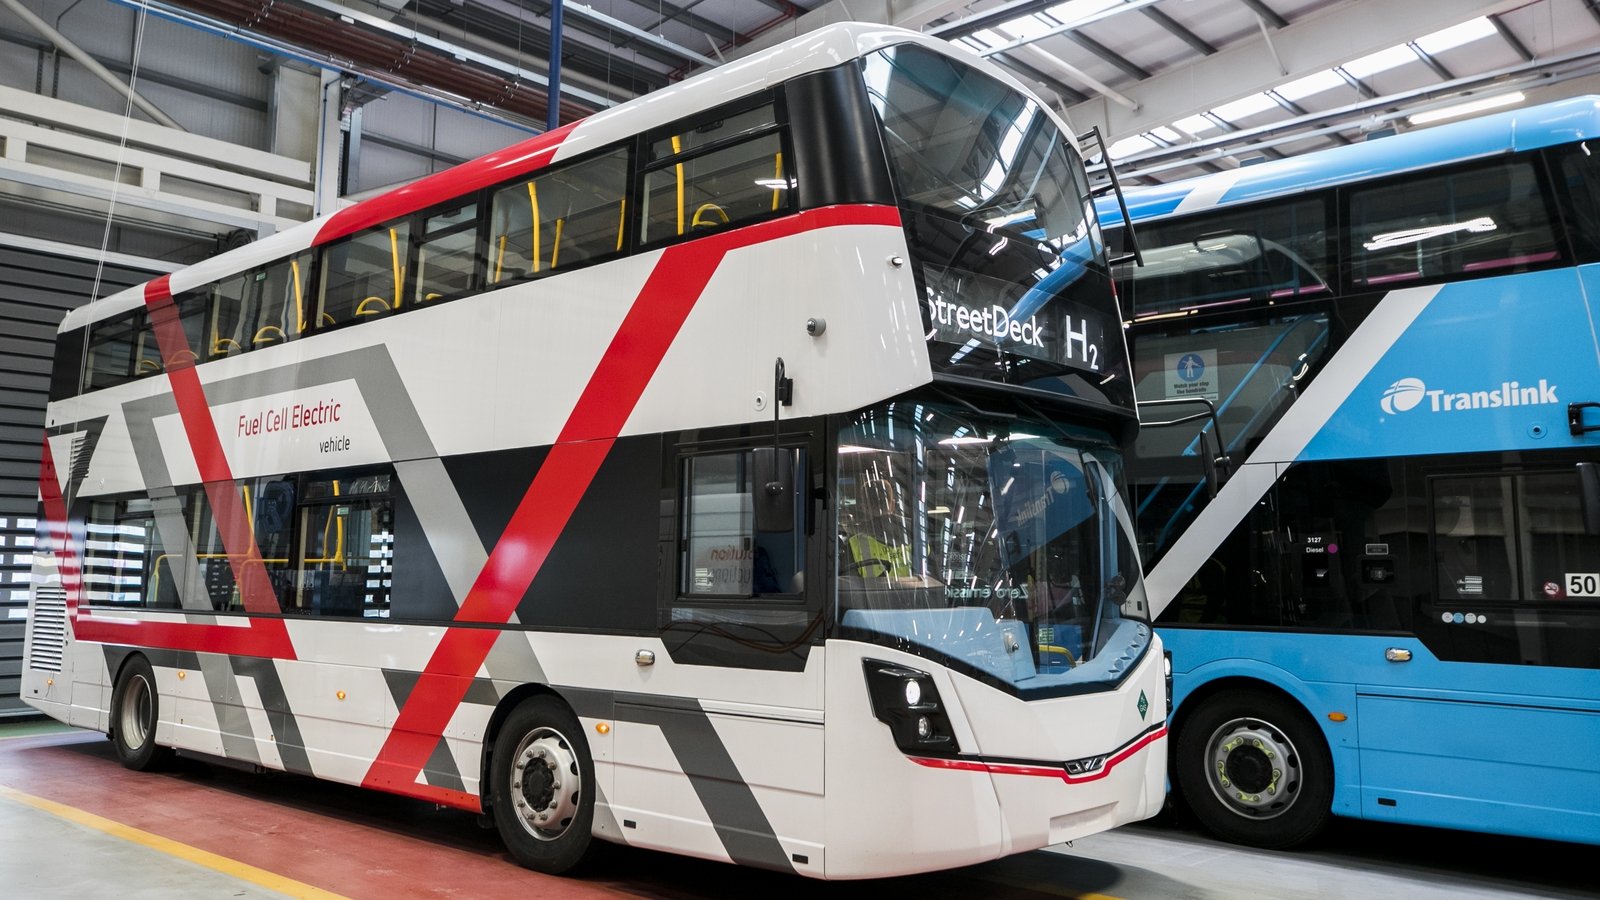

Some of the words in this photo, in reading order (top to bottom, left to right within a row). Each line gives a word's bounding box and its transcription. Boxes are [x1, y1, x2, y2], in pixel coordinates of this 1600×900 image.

[926, 286, 1044, 348] StreetDeck
[1426, 379, 1559, 412] Translink
[237, 411, 263, 438] Fuel
[266, 407, 288, 433] Cell
[291, 398, 341, 429] Electric
[319, 435, 351, 453] vehicle
[1570, 575, 1596, 594] 50
